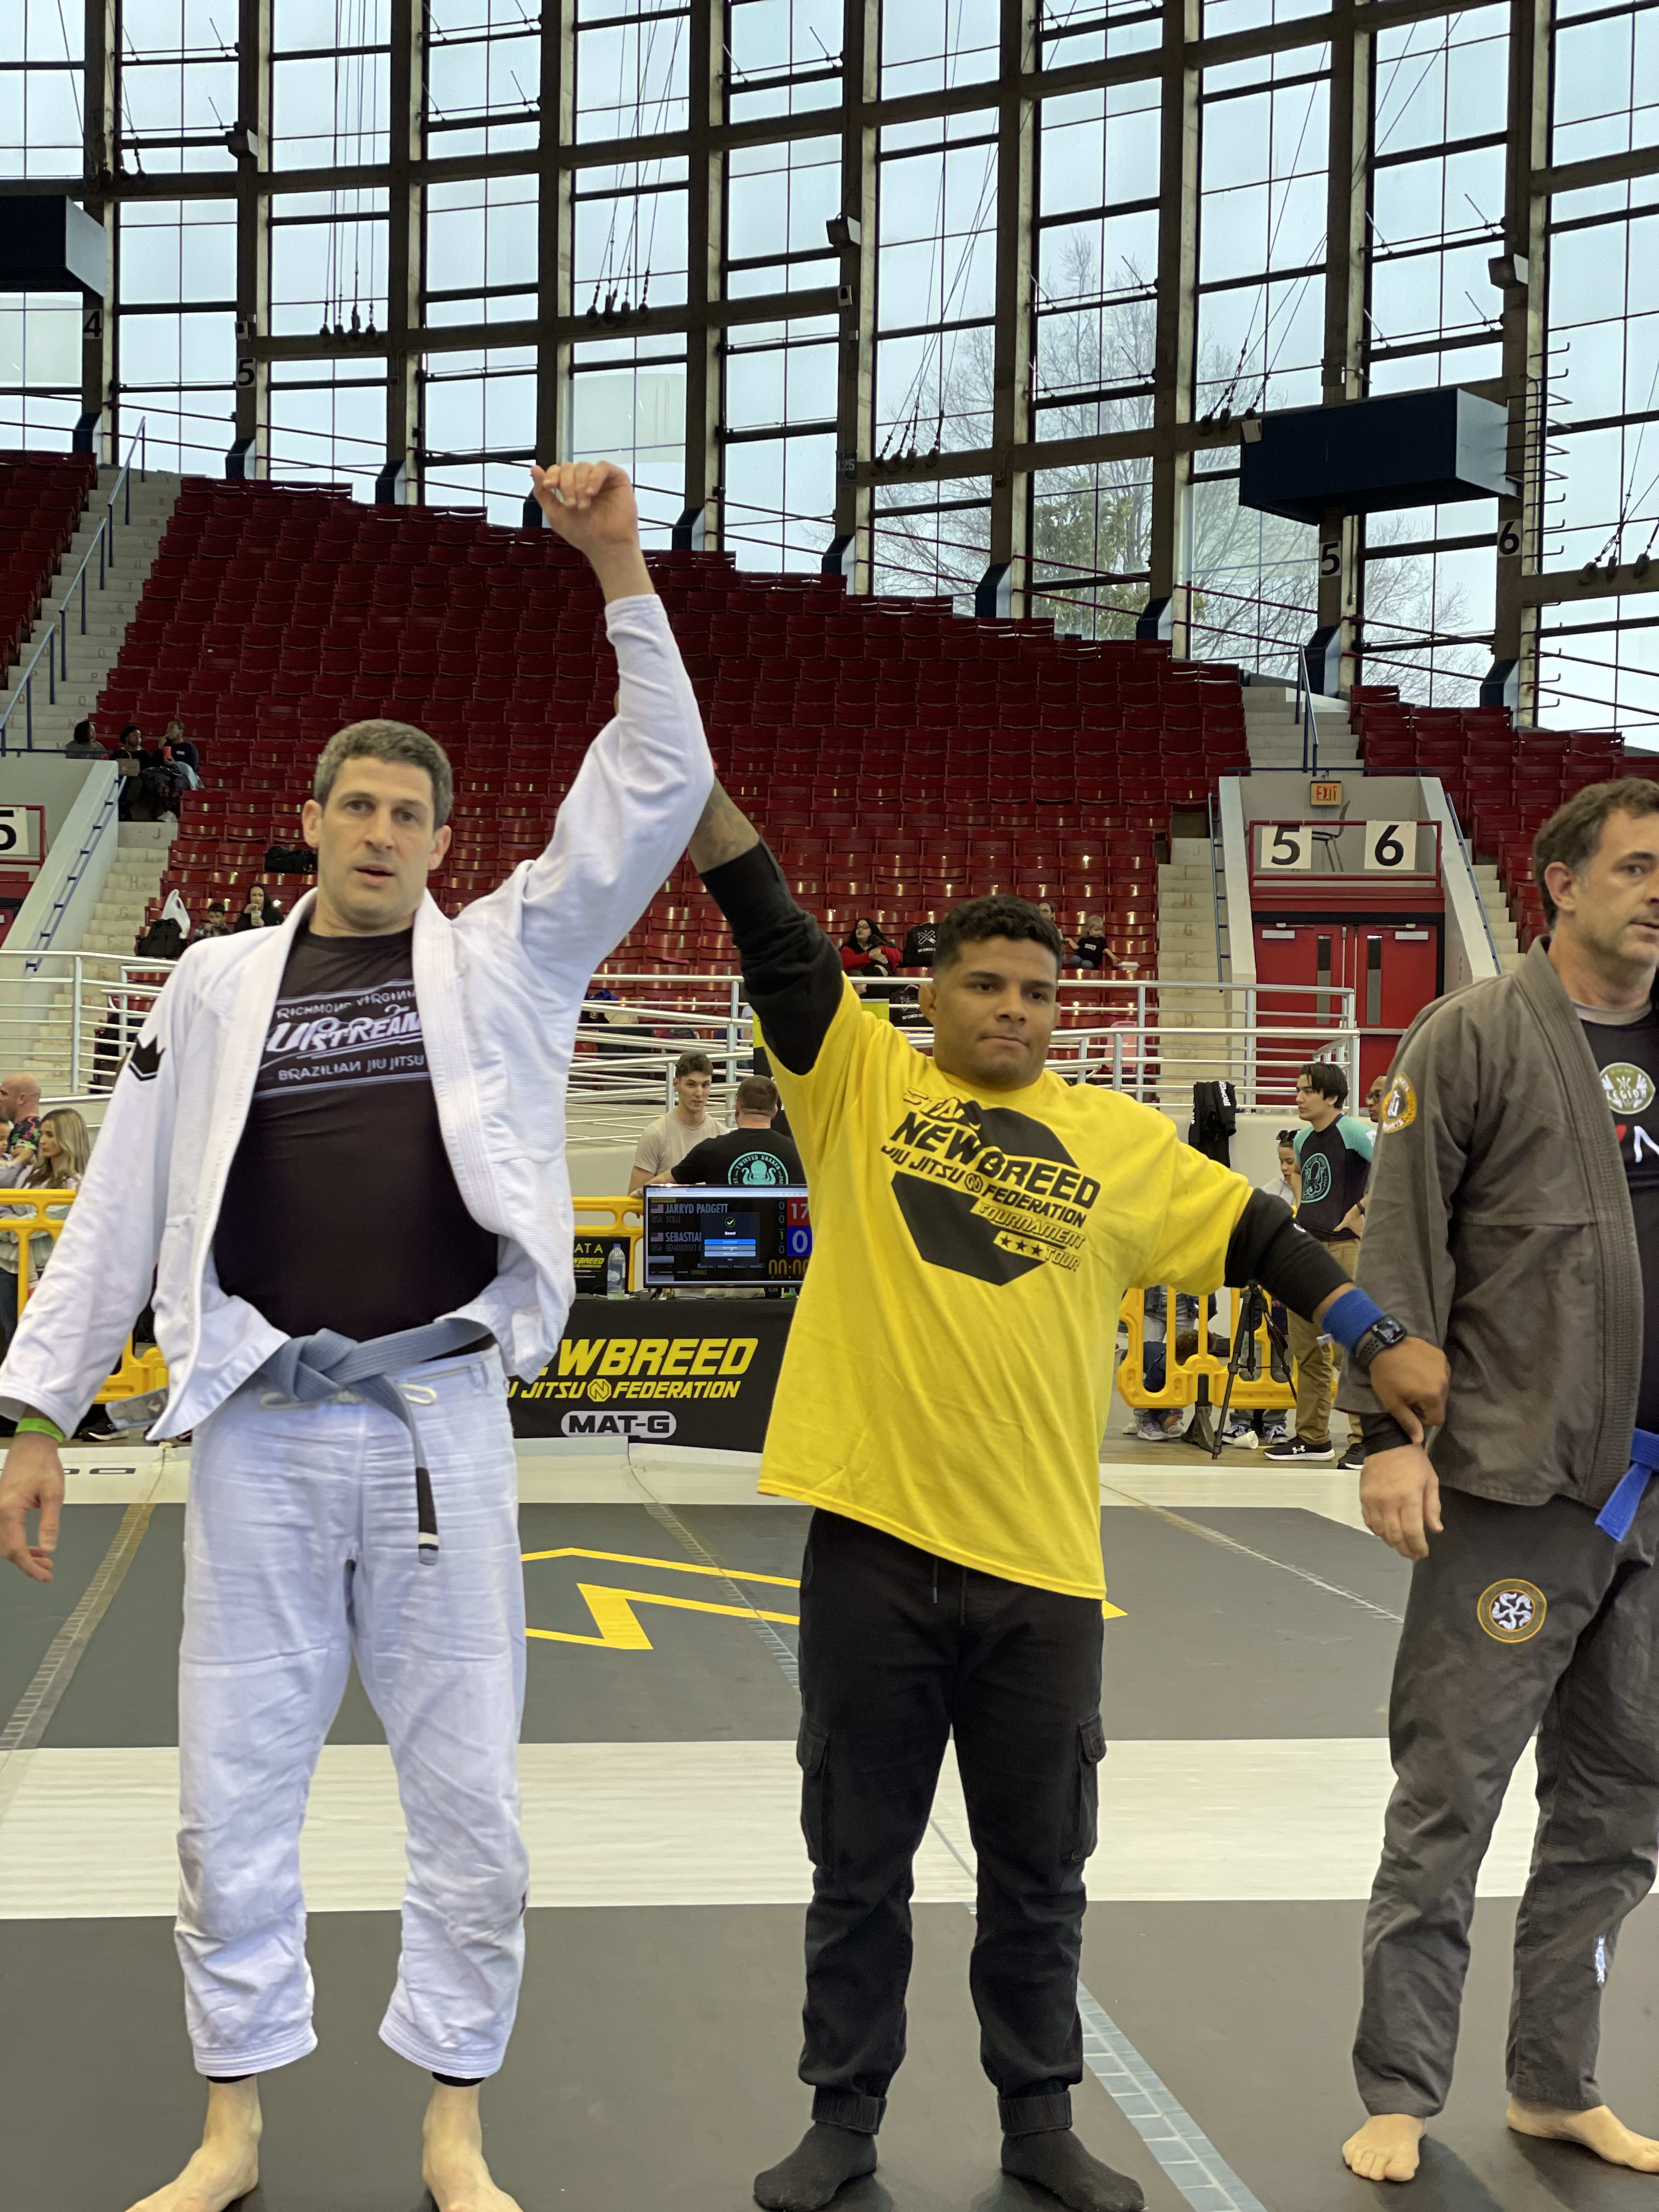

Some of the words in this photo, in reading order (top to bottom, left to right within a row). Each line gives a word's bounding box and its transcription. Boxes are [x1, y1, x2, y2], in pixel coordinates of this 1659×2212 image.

[83, 312, 101, 337] 4
[238, 359, 255, 386] 5
[1499, 522, 1520, 555] 6
[1321, 542, 1340, 575] 5
[1316, 786, 1338, 801] EXIT
[1271, 825, 1300, 865] 5
[1374, 825, 1404, 866] 6
[278, 1060, 362, 1081] BRAZILIAN
[366, 1058, 387, 1073] JIU
[390, 1055, 425, 1070] JITSU
[1606, 1088, 1646, 1101] LEGION
[735, 1154, 759, 1170] TWISTED
[761, 1155, 781, 1170] KRAKEN
[890, 1111, 1102, 1210] NEWBREED
[881, 1145, 912, 1166] JIU
[909, 1156, 967, 1183] JITSU
[981, 1183, 1087, 1228] FEDERATION
[665, 1203, 694, 1214] JARRYD
[696, 1203, 729, 1214] PADGETT
[791, 1203, 809, 1219] 17
[979, 1202, 1086, 1250] TOURNAMENT
[792, 1230, 808, 1253] 0
[1045, 1246, 1081, 1272] TOUR
[538, 1338, 759, 1376] WBREED
[521, 1381, 587, 1398] JITSU
[612, 1380, 741, 1398] FEDERATION
[569, 1415, 670, 1433] MAT-G
